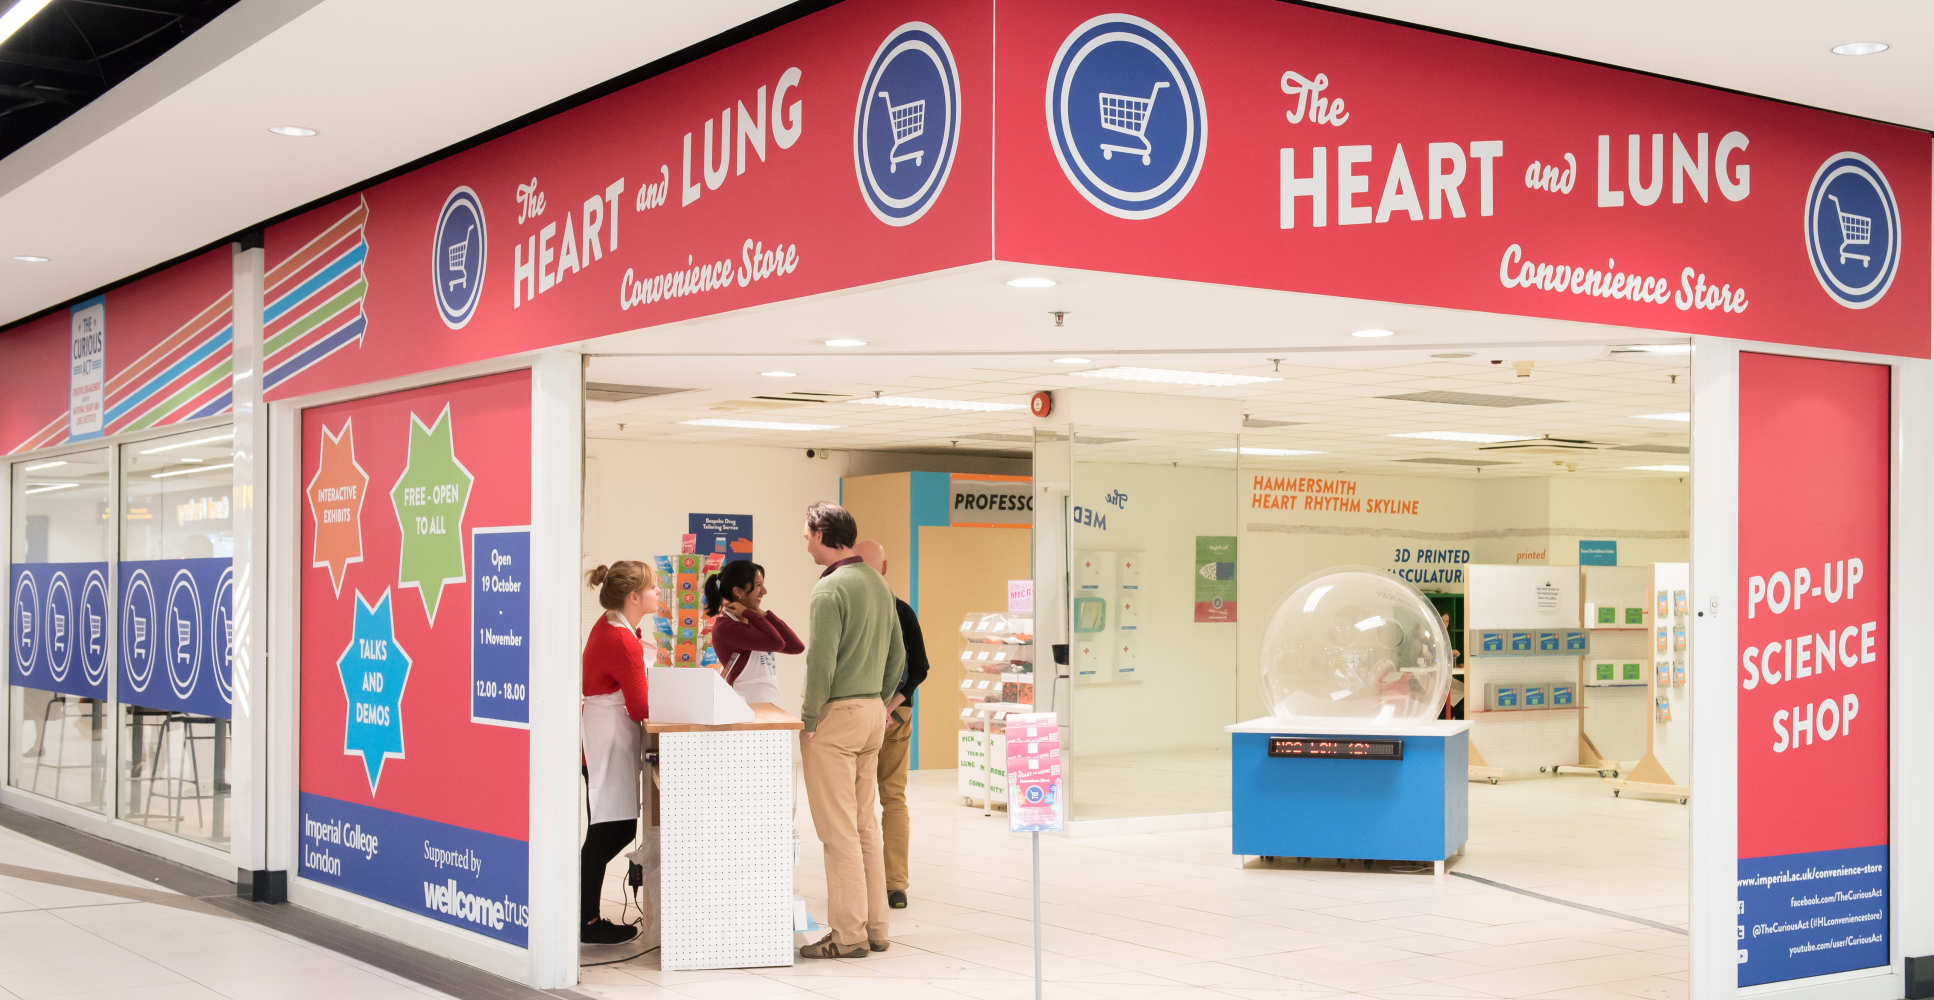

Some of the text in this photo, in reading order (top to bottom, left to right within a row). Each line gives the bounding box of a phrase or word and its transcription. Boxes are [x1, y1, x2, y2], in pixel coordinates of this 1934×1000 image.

[1281, 70, 1349, 127] The
[513, 66, 802, 310] HEART and LUNG
[1280, 130, 1750, 229] HEART and LUNG
[516, 177, 546, 225] The
[620, 238, 799, 311] Convenience Store
[1500, 243, 1749, 314] Convenience Store
[73, 331, 102, 360] CURIOUS
[318, 486, 357, 503] INTERACTIVE
[404, 487, 427, 506] FREE
[432, 485, 460, 504] OPEN
[1253, 475, 1357, 495] HAMMERSMITH
[323, 508, 351, 523] EXHIBITS
[1251, 494, 1420, 515] HEART RHYTHM SKYLINE
[415, 516, 447, 535] TO ALL
[491, 549, 512, 572] Open
[1394, 548, 1470, 564] 3D PRINTED
[1515, 549, 1546, 564] printed
[481, 576, 521, 593] 19 October
[1387, 568, 1465, 583] SCULATUR
[1748, 557, 1864, 619] POP-UP
[480, 628, 523, 647] 1 November
[359, 638, 387, 661] TALKS
[1742, 621, 1877, 690] SCIENCE
[362, 671, 384, 693] AND
[476, 680, 497, 698] 12.00
[503, 683, 526, 701] 18.00
[356, 703, 390, 727] DEMOS
[1772, 693, 1859, 753] SHOP
[305, 813, 379, 861] Imperial College
[305, 844, 341, 877] London
[424, 840, 482, 878] Supported by
[1790, 888, 1882, 907] facebook.com/TheCuriousAct
[1752, 920, 1810, 938] @TheCuriousAct
[1789, 934, 1882, 958] youtube.com/user/CuriousAct
